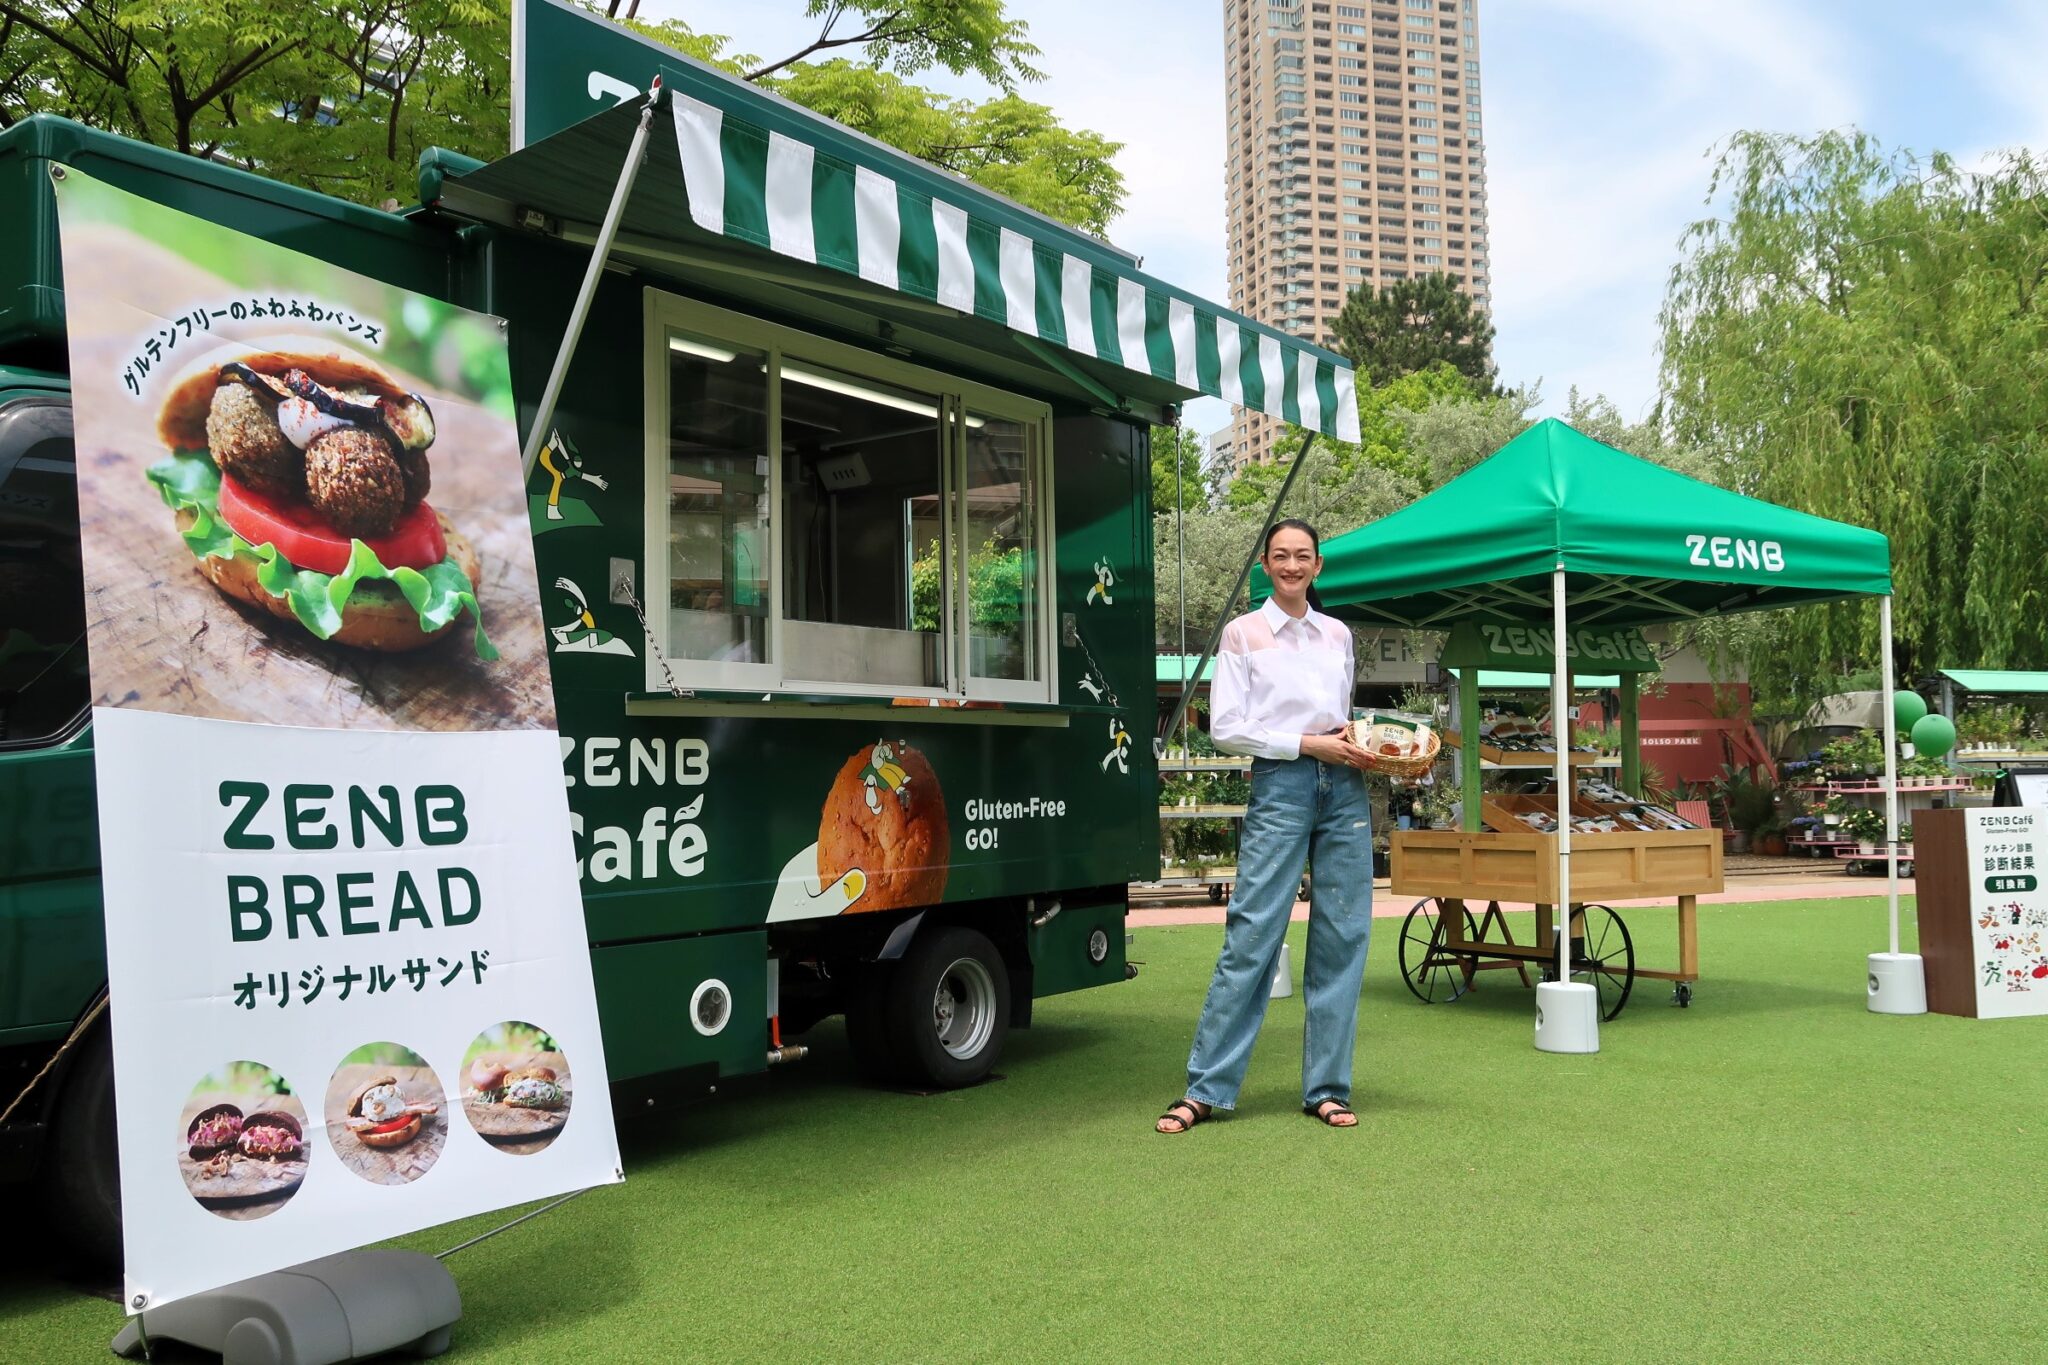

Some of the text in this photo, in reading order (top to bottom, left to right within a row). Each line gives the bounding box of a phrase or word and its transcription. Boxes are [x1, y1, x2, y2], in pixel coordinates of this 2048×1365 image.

[123, 297, 382, 396] グルテンフリーのふわふわバンズ
[1685, 534, 1785, 572] ZENB
[1576, 628, 1650, 662] Café
[218, 780, 469, 850] ZENB
[964, 797, 1066, 822] Gluten-Free
[1979, 815, 2034, 826] ZENB Café
[965, 827, 999, 851] GO!
[1984, 855, 2036, 871] 診断結果
[1995, 878, 2026, 890] 引換所
[227, 867, 482, 942] BREAD
[233, 950, 490, 1010] オリジナルサンド
